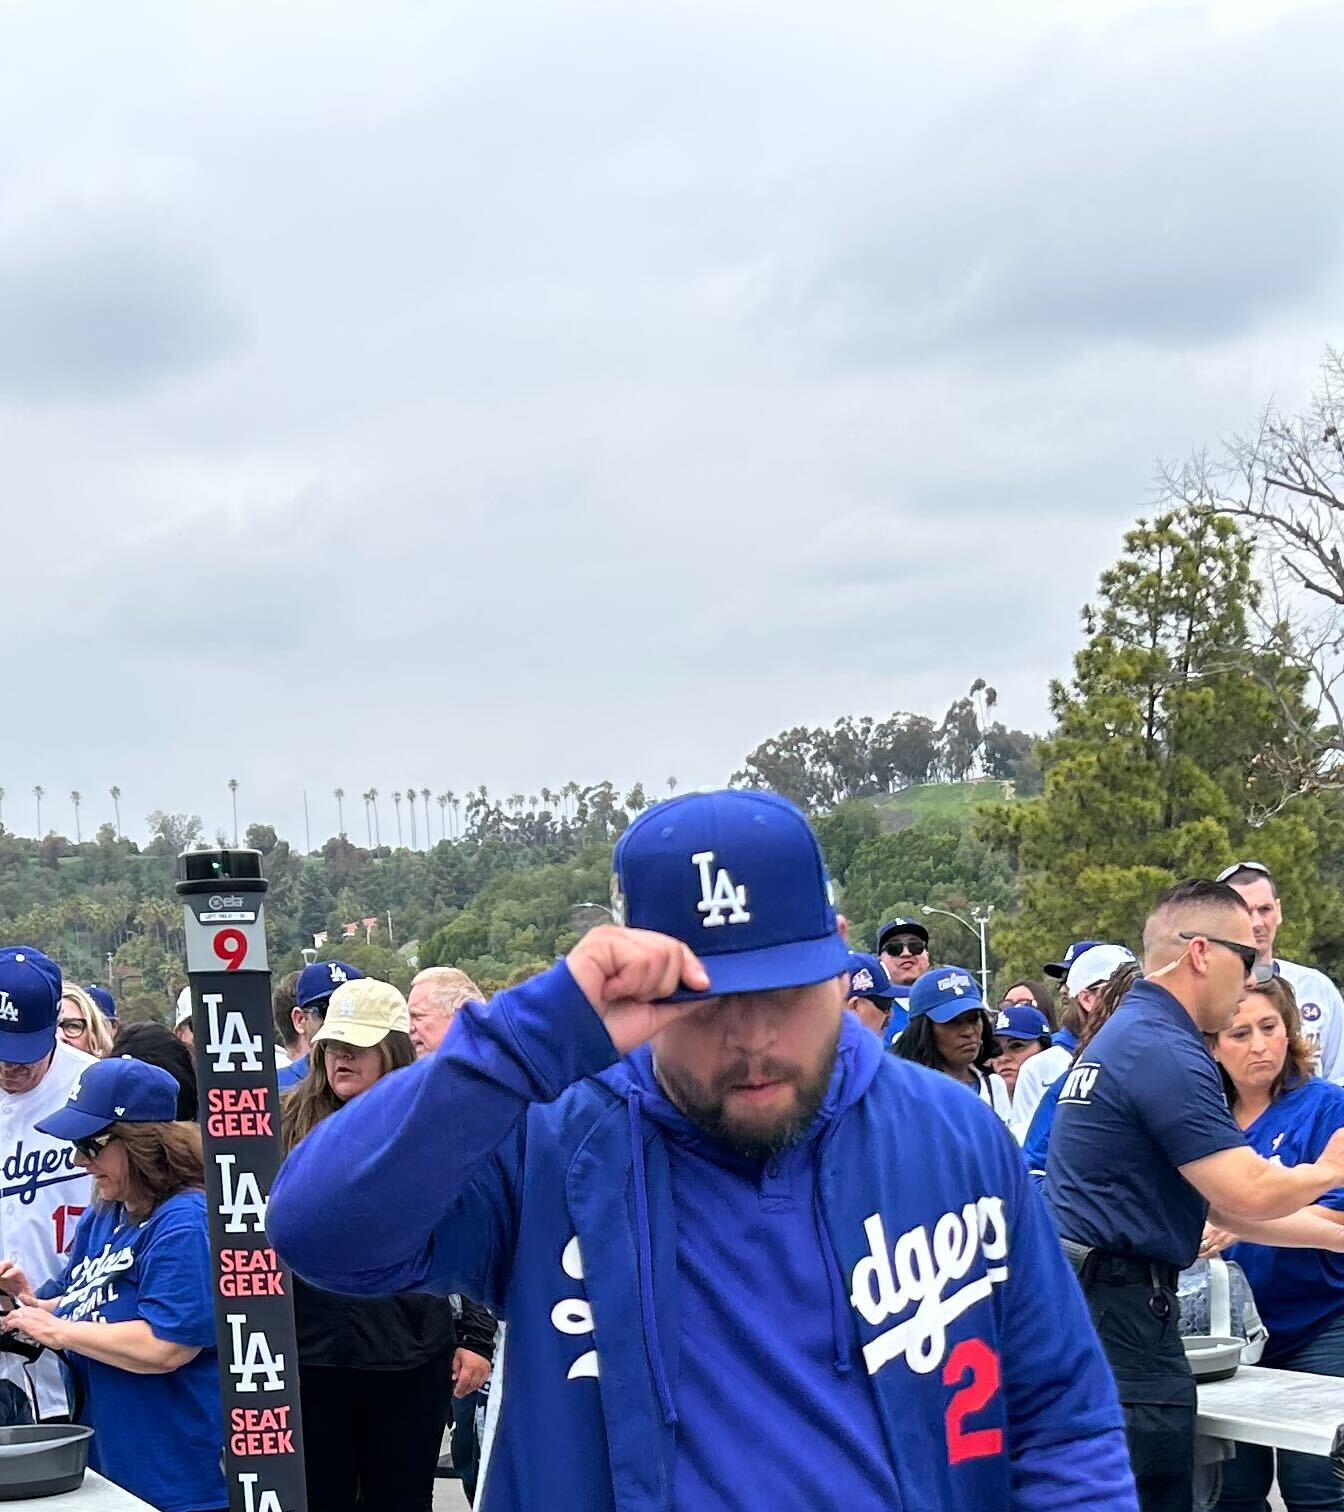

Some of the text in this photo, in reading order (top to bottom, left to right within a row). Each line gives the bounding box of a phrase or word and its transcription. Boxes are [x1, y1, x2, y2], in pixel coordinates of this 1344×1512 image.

[692, 851, 750, 927] LA
[213, 928, 247, 972] 9
[328, 963, 347, 982] LA
[1303, 1006, 1318, 1018] 34
[202, 994, 263, 1072] LA
[208, 1088, 268, 1112] SEAT
[207, 1112, 273, 1137] GEEK
[215, 1154, 268, 1233] LA
[220, 1249, 277, 1272] SEAT
[219, 1272, 285, 1297] GEEK
[226, 1314, 285, 1392] LA
[942, 1338, 1003, 1465] 2
[231, 1406, 290, 1432] SEAT
[230, 1430, 295, 1456] GEEK
